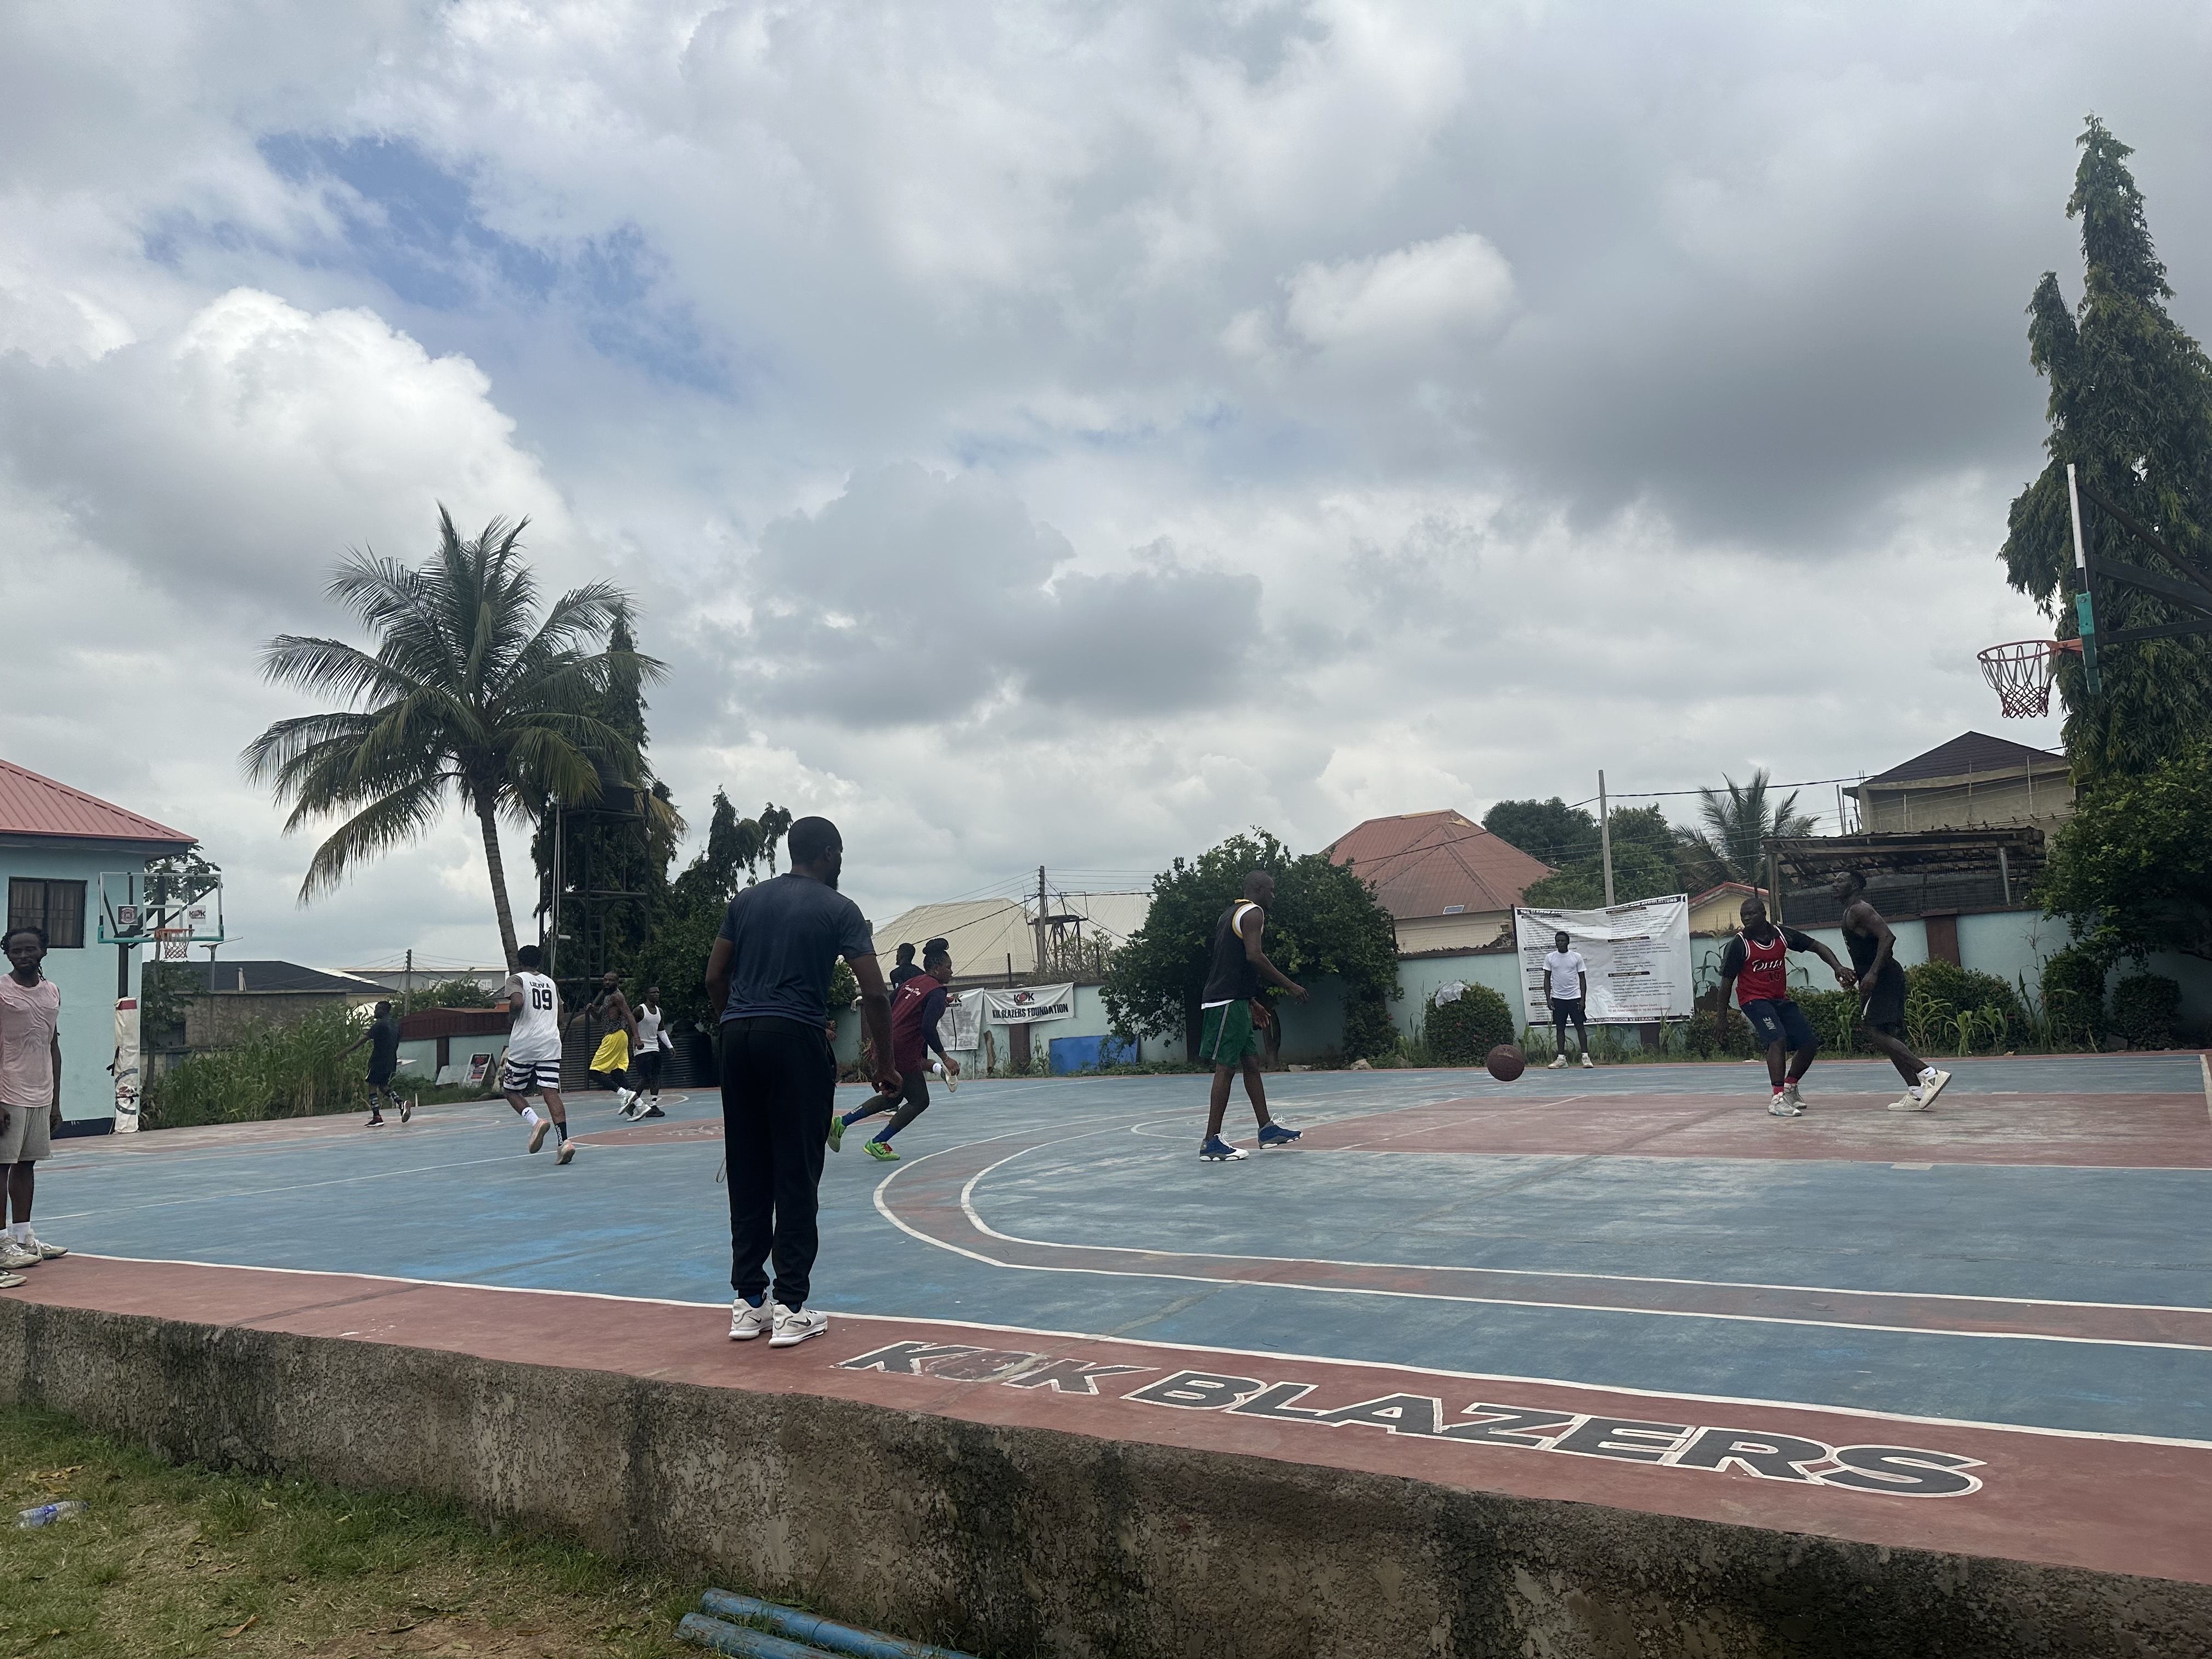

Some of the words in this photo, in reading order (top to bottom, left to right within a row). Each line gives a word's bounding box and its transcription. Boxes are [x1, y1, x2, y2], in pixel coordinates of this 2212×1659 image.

[532, 988, 552, 1010] 09
[1001, 1008, 1026, 1019] BLAZERS
[1027, 1003, 1069, 1017] FOUNDATION
[1763, 1017, 1777, 1030] NIKE
[830, 1340, 1161, 1396] KOK
[1119, 1369, 1988, 1498] BLAZERS
